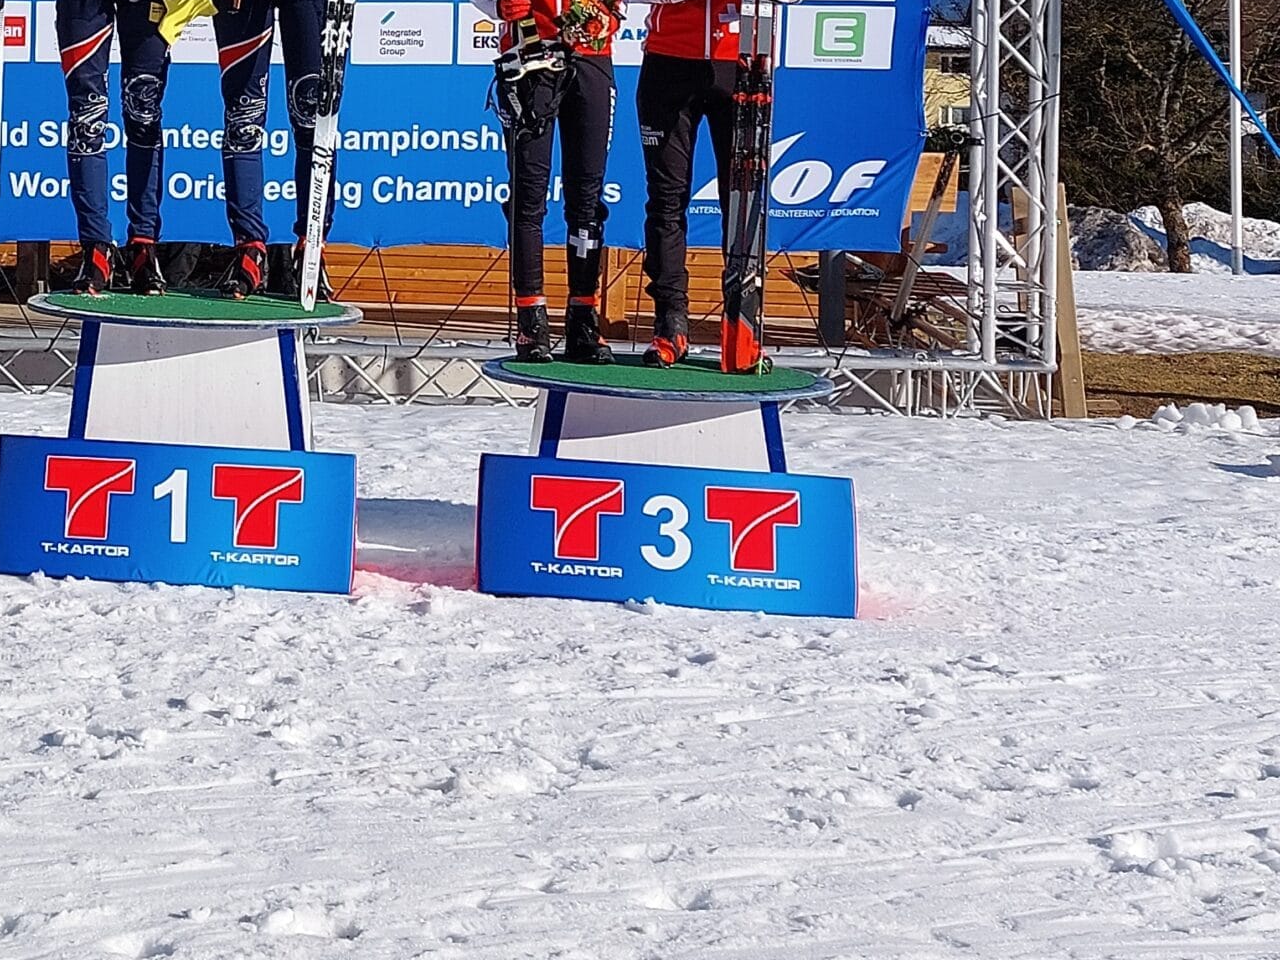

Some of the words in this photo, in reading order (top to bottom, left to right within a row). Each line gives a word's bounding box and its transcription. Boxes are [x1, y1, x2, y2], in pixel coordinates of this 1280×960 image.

[380, 28, 421, 38] Integrated
[380, 38, 423, 48] Consulting
[380, 48, 405, 57] Group
[311, 176, 323, 224] REDLINE
[153, 469, 188, 543] 1
[640, 495, 692, 571] 3
[41, 542, 130, 557] T-KARTOR
[210, 551, 300, 566] T-KARTOR
[530, 561, 623, 578] T-KARTOR
[707, 574, 801, 591] T-KARTOR
